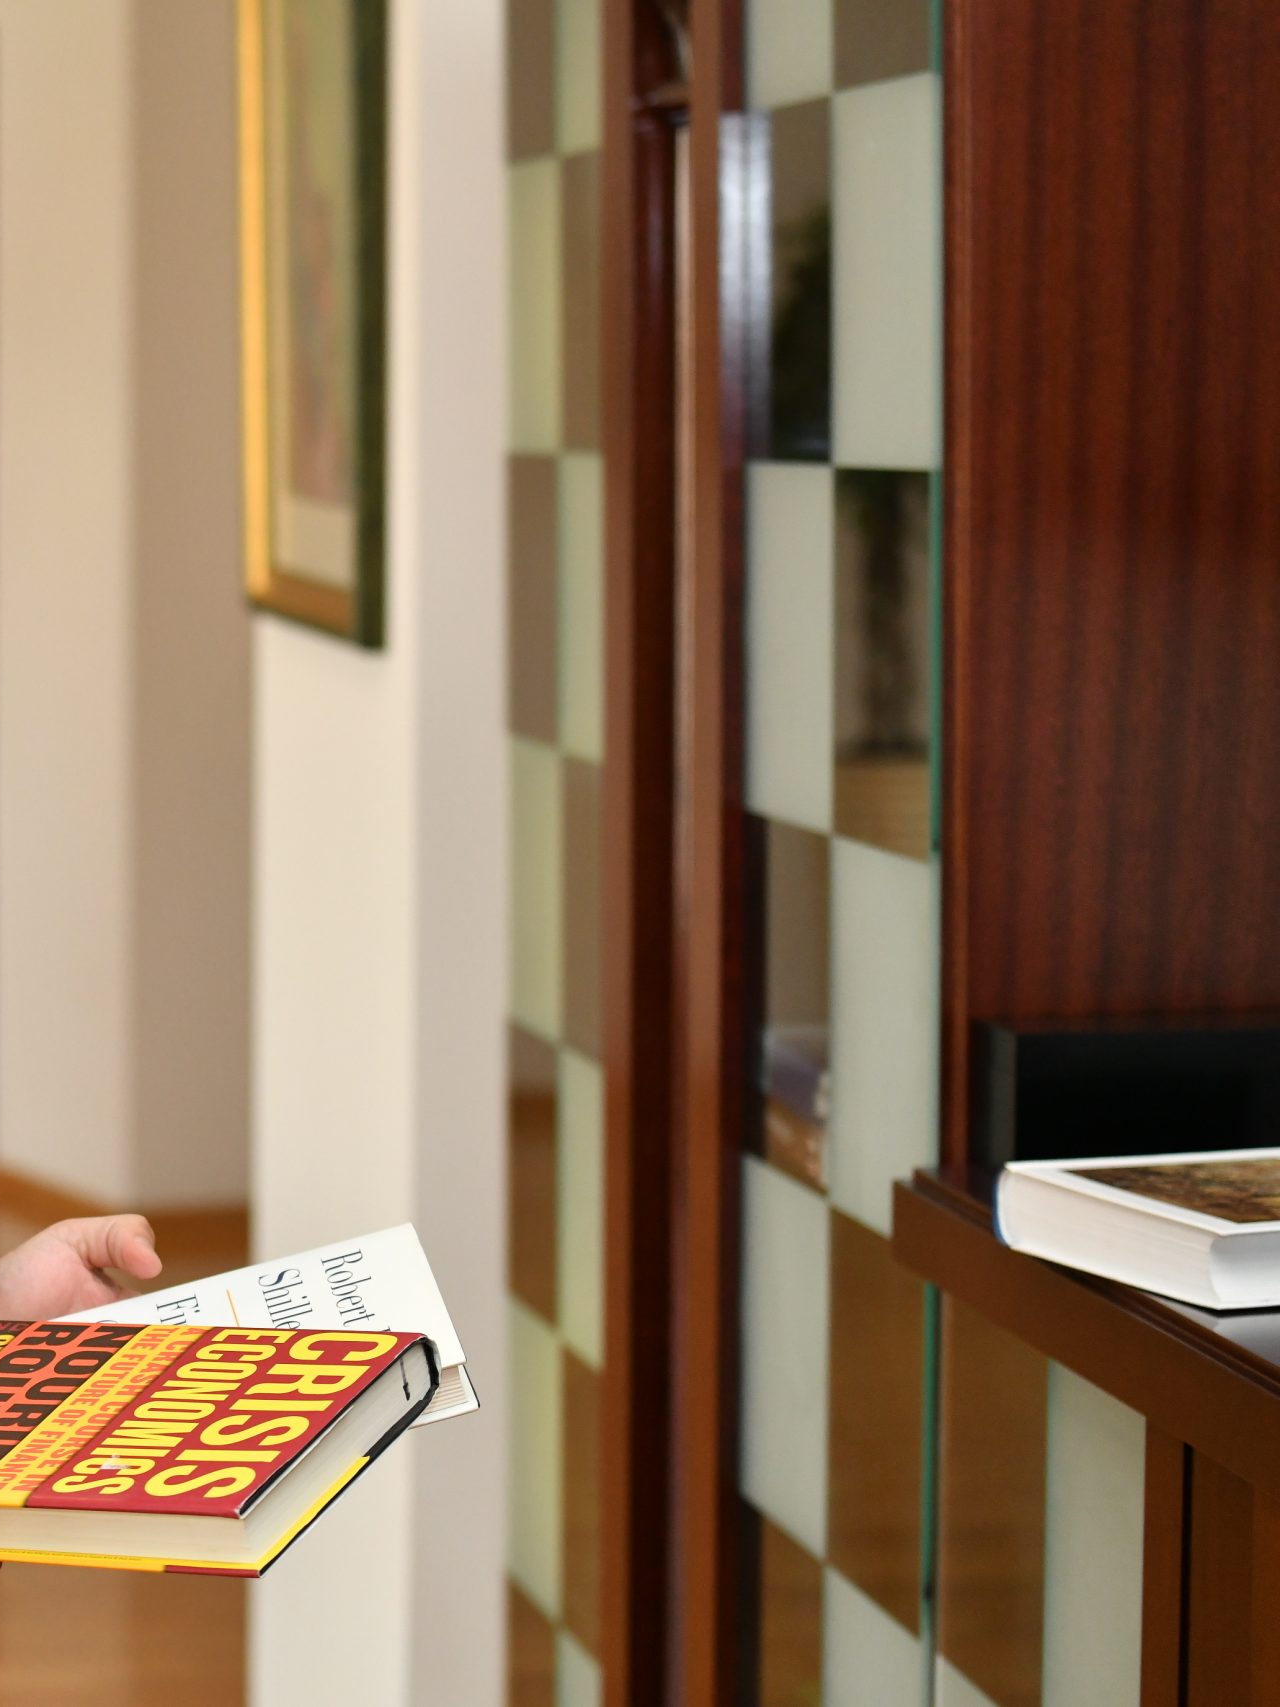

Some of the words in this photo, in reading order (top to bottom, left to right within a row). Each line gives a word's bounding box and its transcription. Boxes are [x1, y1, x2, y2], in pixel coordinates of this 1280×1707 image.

[258, 1268, 313, 1328] Shille
[321, 1248, 375, 1327] Robert
[130, 1327, 176, 1351] THE
[179, 1327, 208, 1336] A
[70, 1353, 148, 1407] FUTURE
[115, 1340, 194, 1398] CRASH
[36, 1402, 124, 1469] COURSE
[51, 1409, 87, 1428] OF
[52, 1329, 298, 1495] ECONOMICS
[144, 1332, 398, 1498] CRISIS
[11, 1474, 46, 1492] IN
